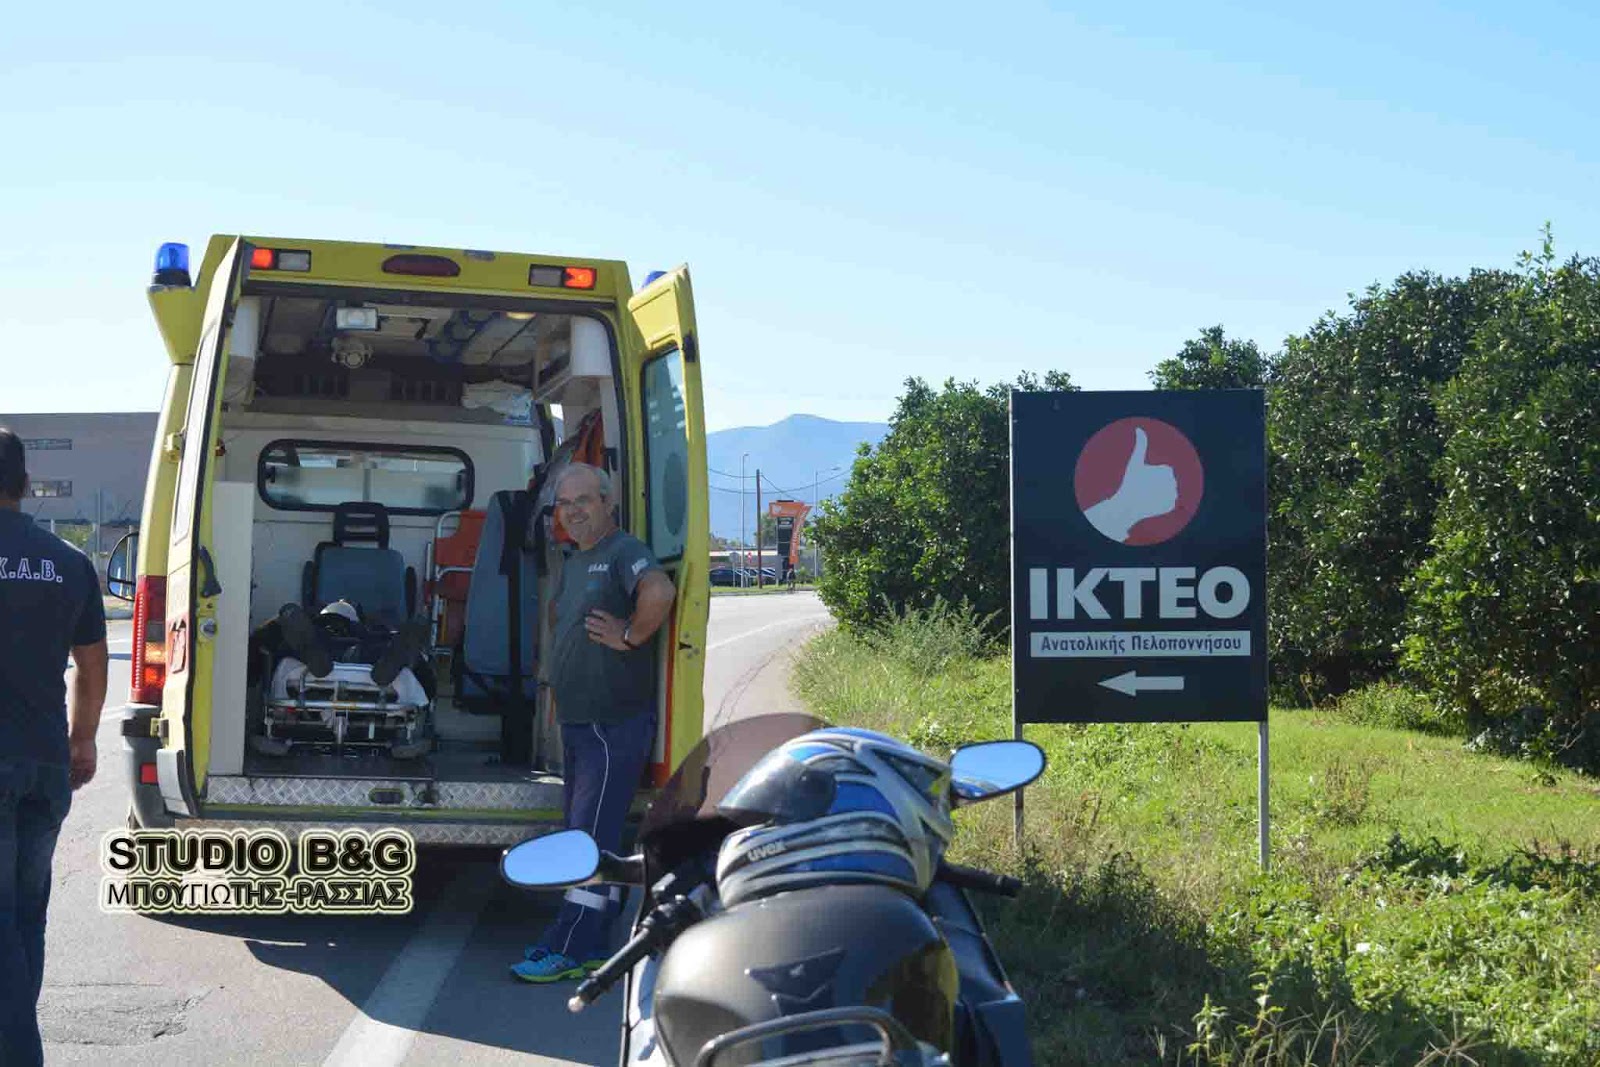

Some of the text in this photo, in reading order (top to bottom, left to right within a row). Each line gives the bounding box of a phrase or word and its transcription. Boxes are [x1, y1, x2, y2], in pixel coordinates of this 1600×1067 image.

[1029, 566, 1250, 619] ΙΚΤΕΟ
[1041, 634, 1242, 655] Ανατολικής Πελοποννήσου
